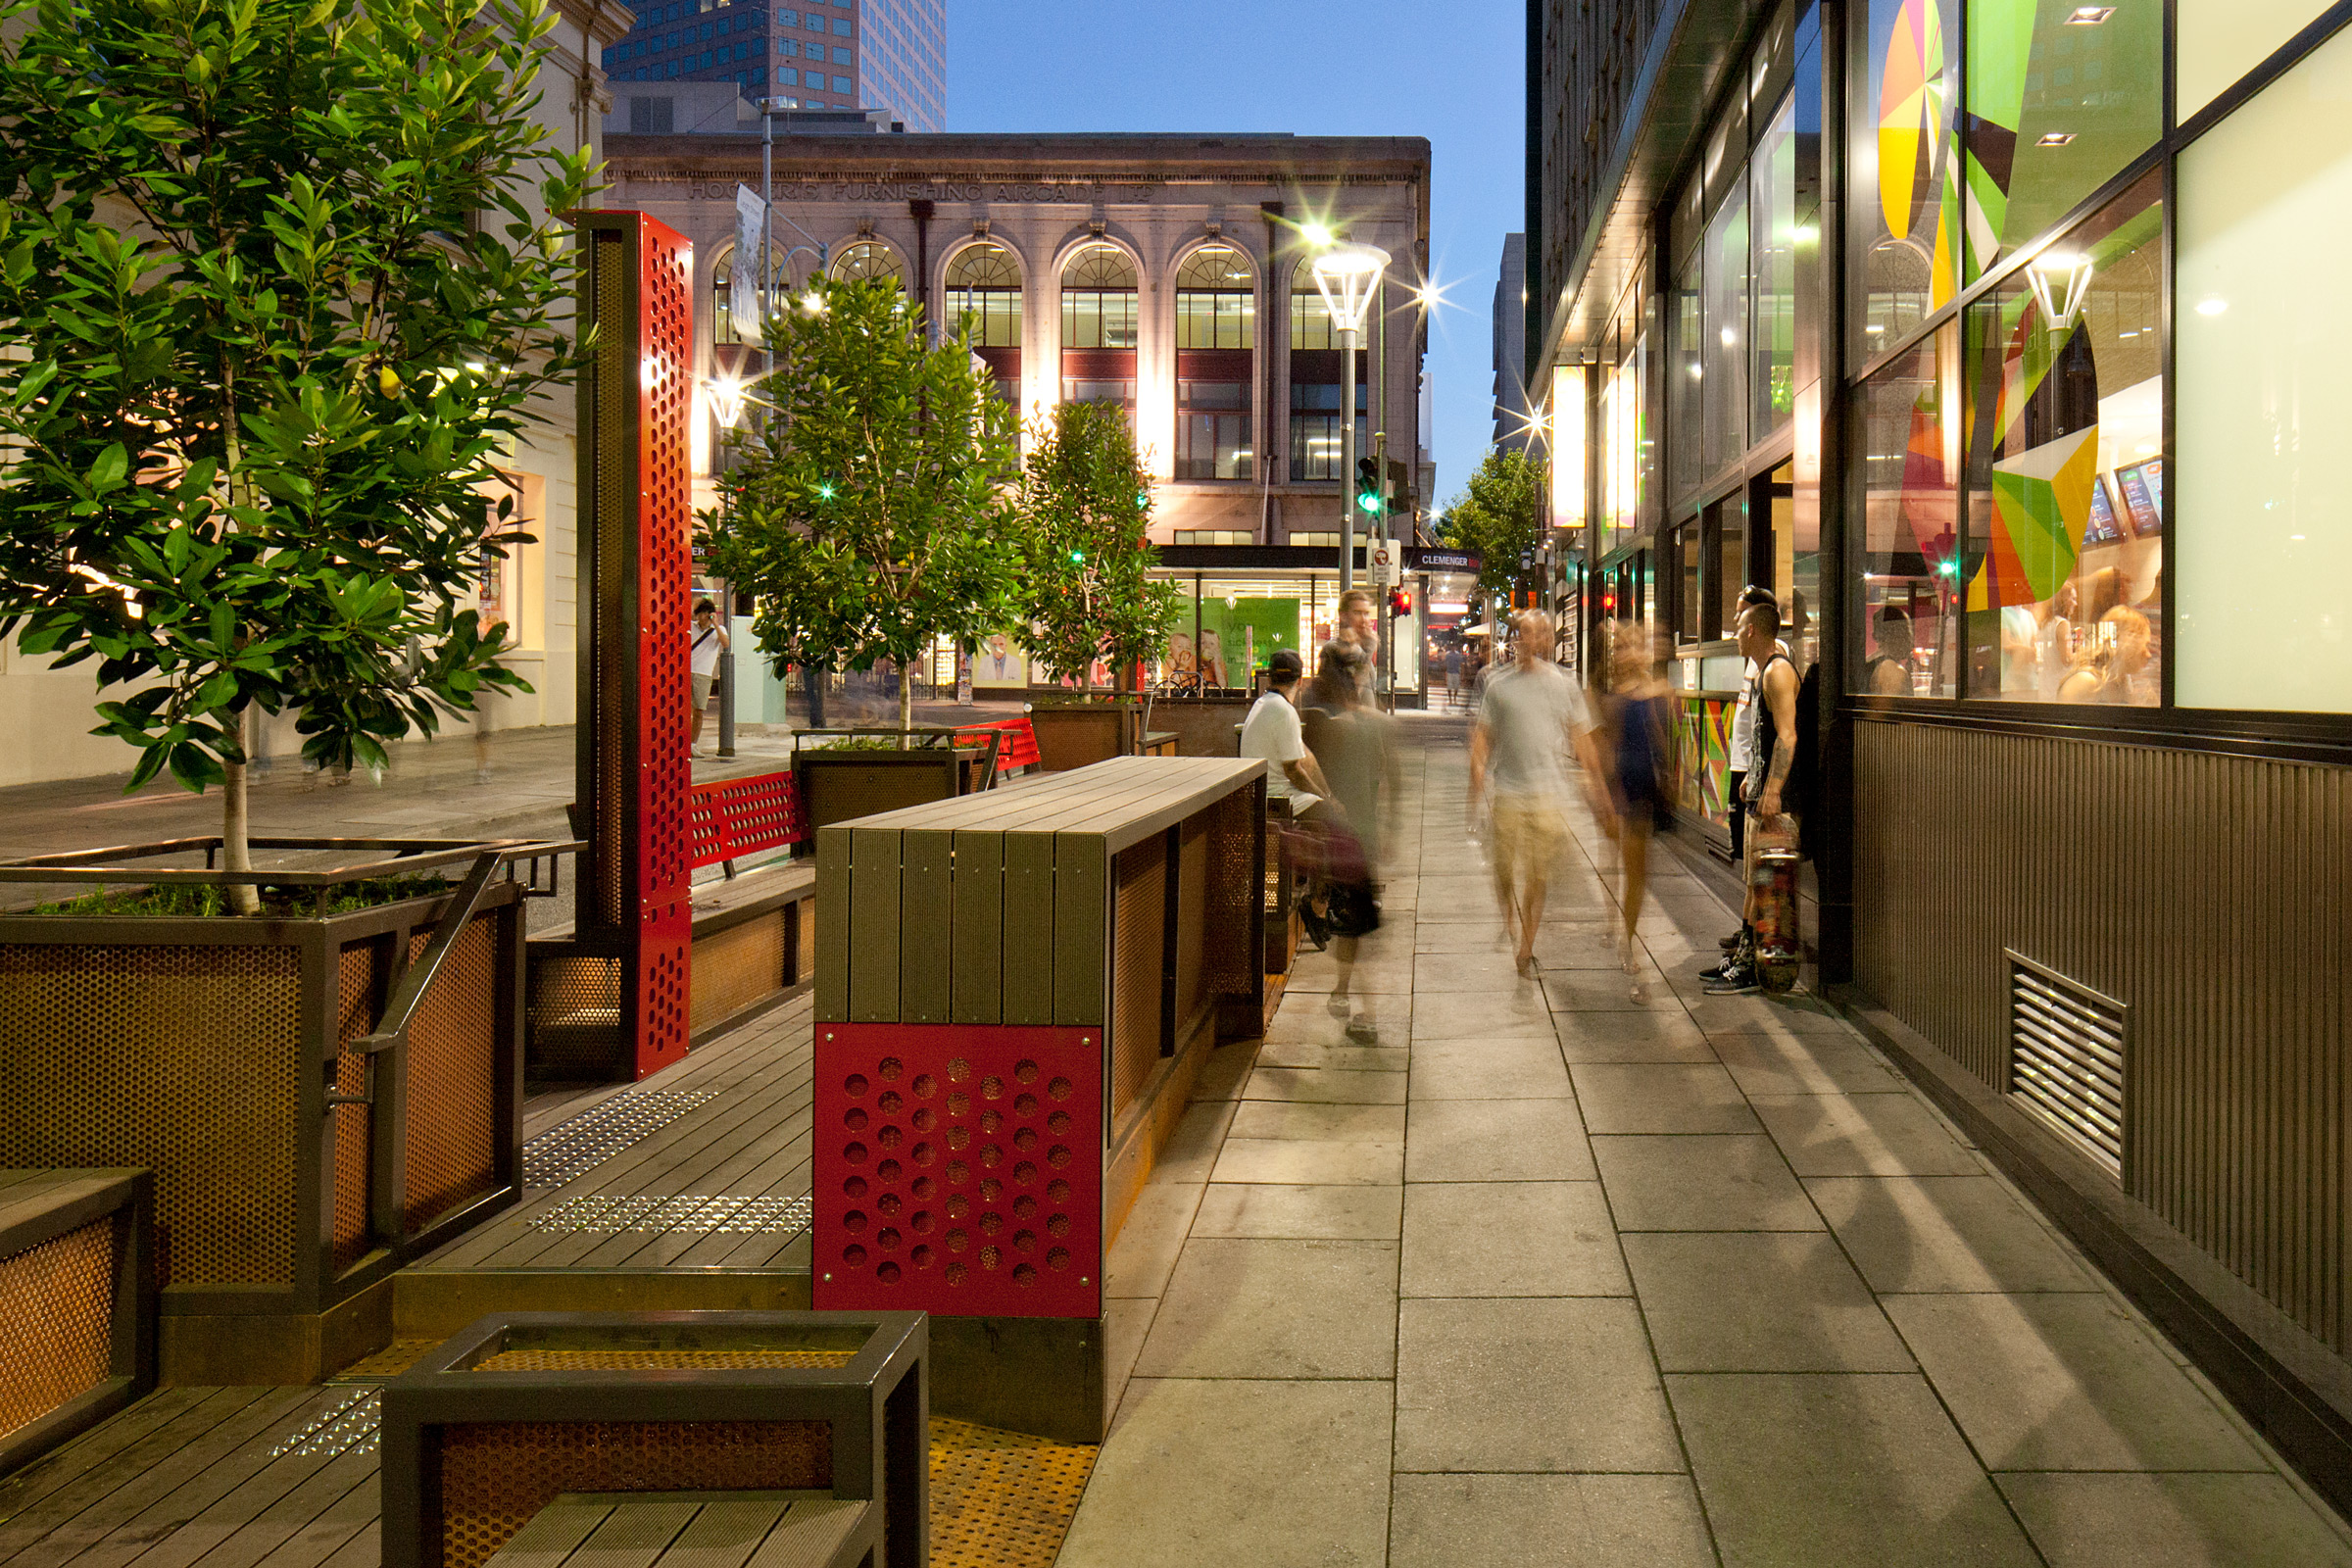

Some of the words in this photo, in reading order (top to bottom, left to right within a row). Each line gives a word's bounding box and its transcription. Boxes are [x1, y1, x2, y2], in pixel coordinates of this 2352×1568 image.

[831, 183, 983, 201] FURNISHING
[994, 184, 1104, 202] ARCADE
[1422, 556, 1468, 566] CLEMENGER
